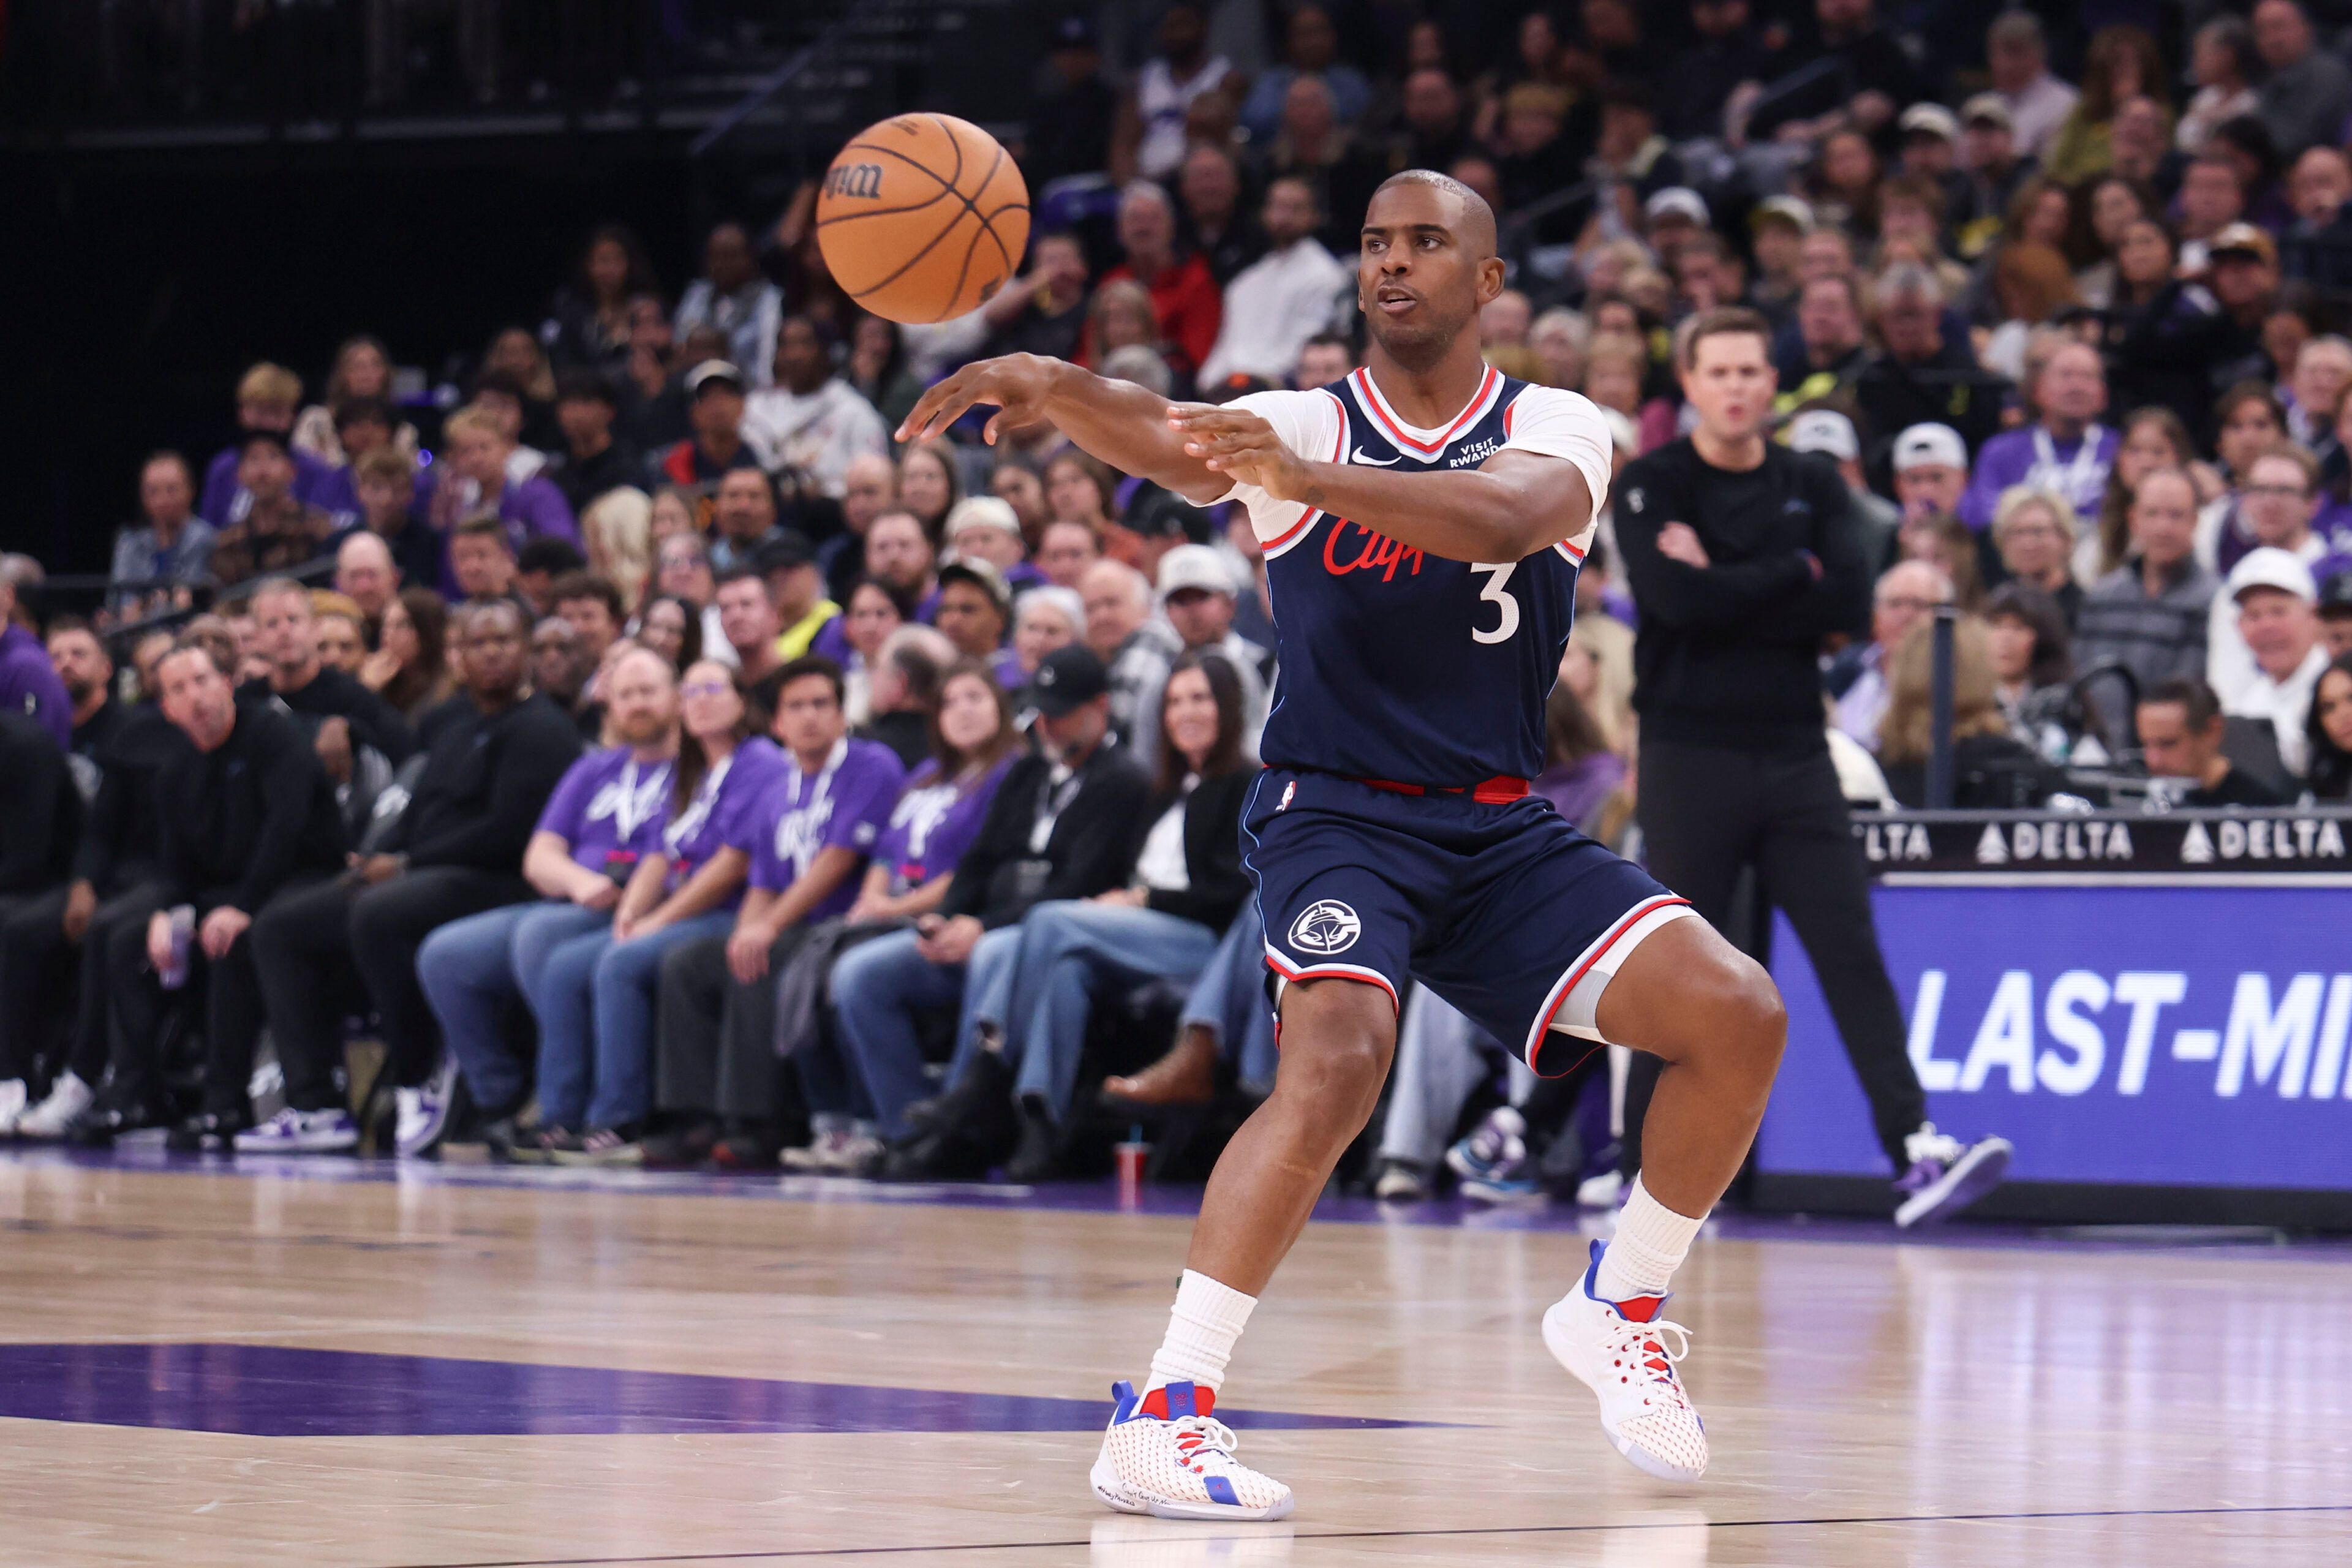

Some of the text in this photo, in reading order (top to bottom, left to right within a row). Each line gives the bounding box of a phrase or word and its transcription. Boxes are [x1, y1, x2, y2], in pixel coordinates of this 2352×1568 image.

[1449, 445, 1500, 469] RWAND
[1460, 437, 1493, 455] VISIT
[1469, 562, 1520, 644] 3
[1851, 818, 2346, 861] LTA DELTA DELTA
[1907, 970, 2352, 1100] LAST-MI
